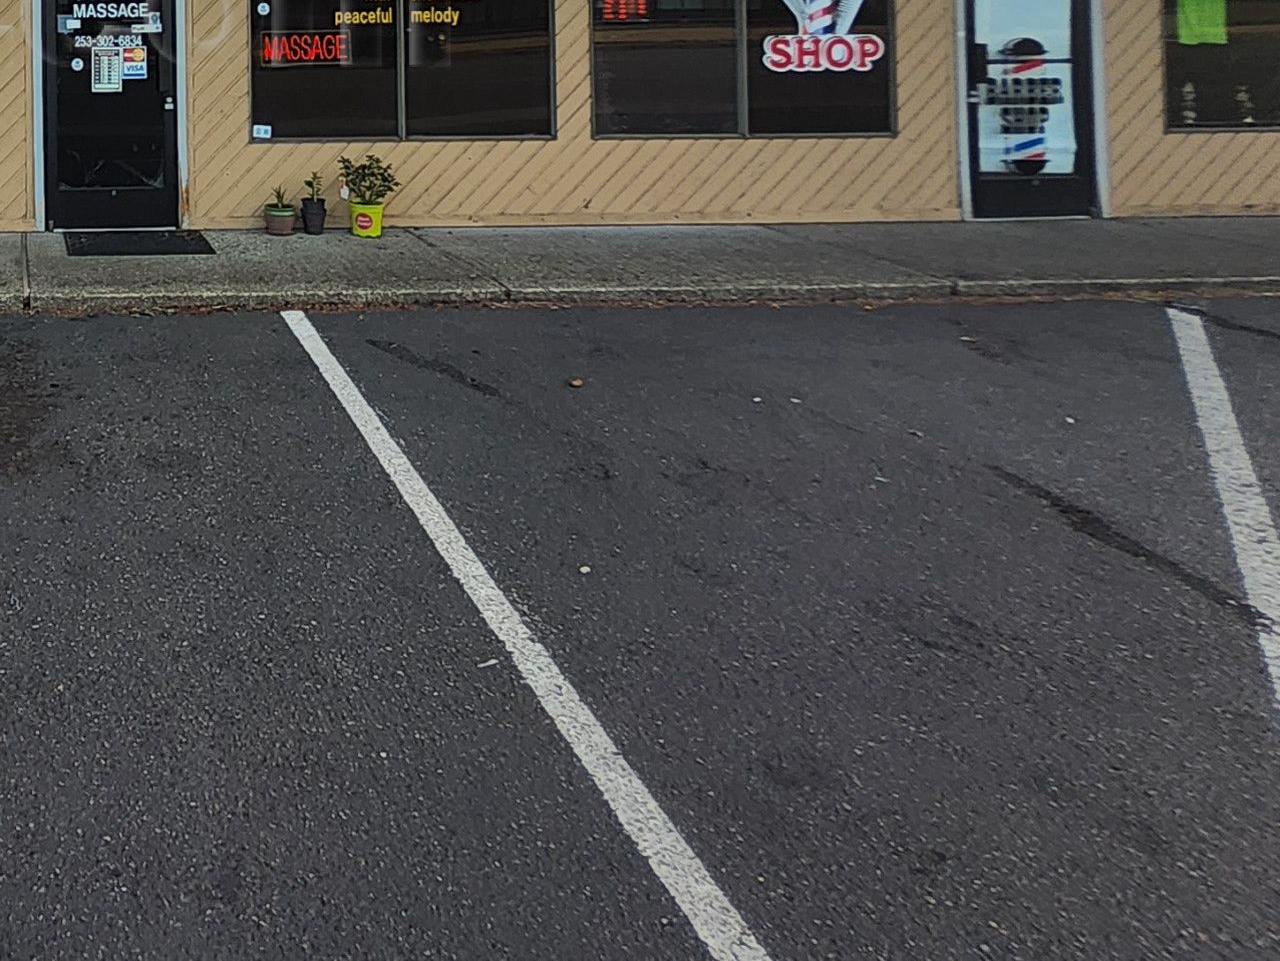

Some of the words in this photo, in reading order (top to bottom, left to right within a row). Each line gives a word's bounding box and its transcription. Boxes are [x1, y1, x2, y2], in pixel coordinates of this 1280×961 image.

[73, 3, 150, 18] MASSAGE
[335, 7, 393, 26] peaceful
[411, 7, 460, 26] melody
[74, 34, 143, 48] 253-302-6834
[264, 34, 349, 61] MASSAGE
[769, 36, 880, 69] SHOP
[125, 64, 145, 72] VISA
